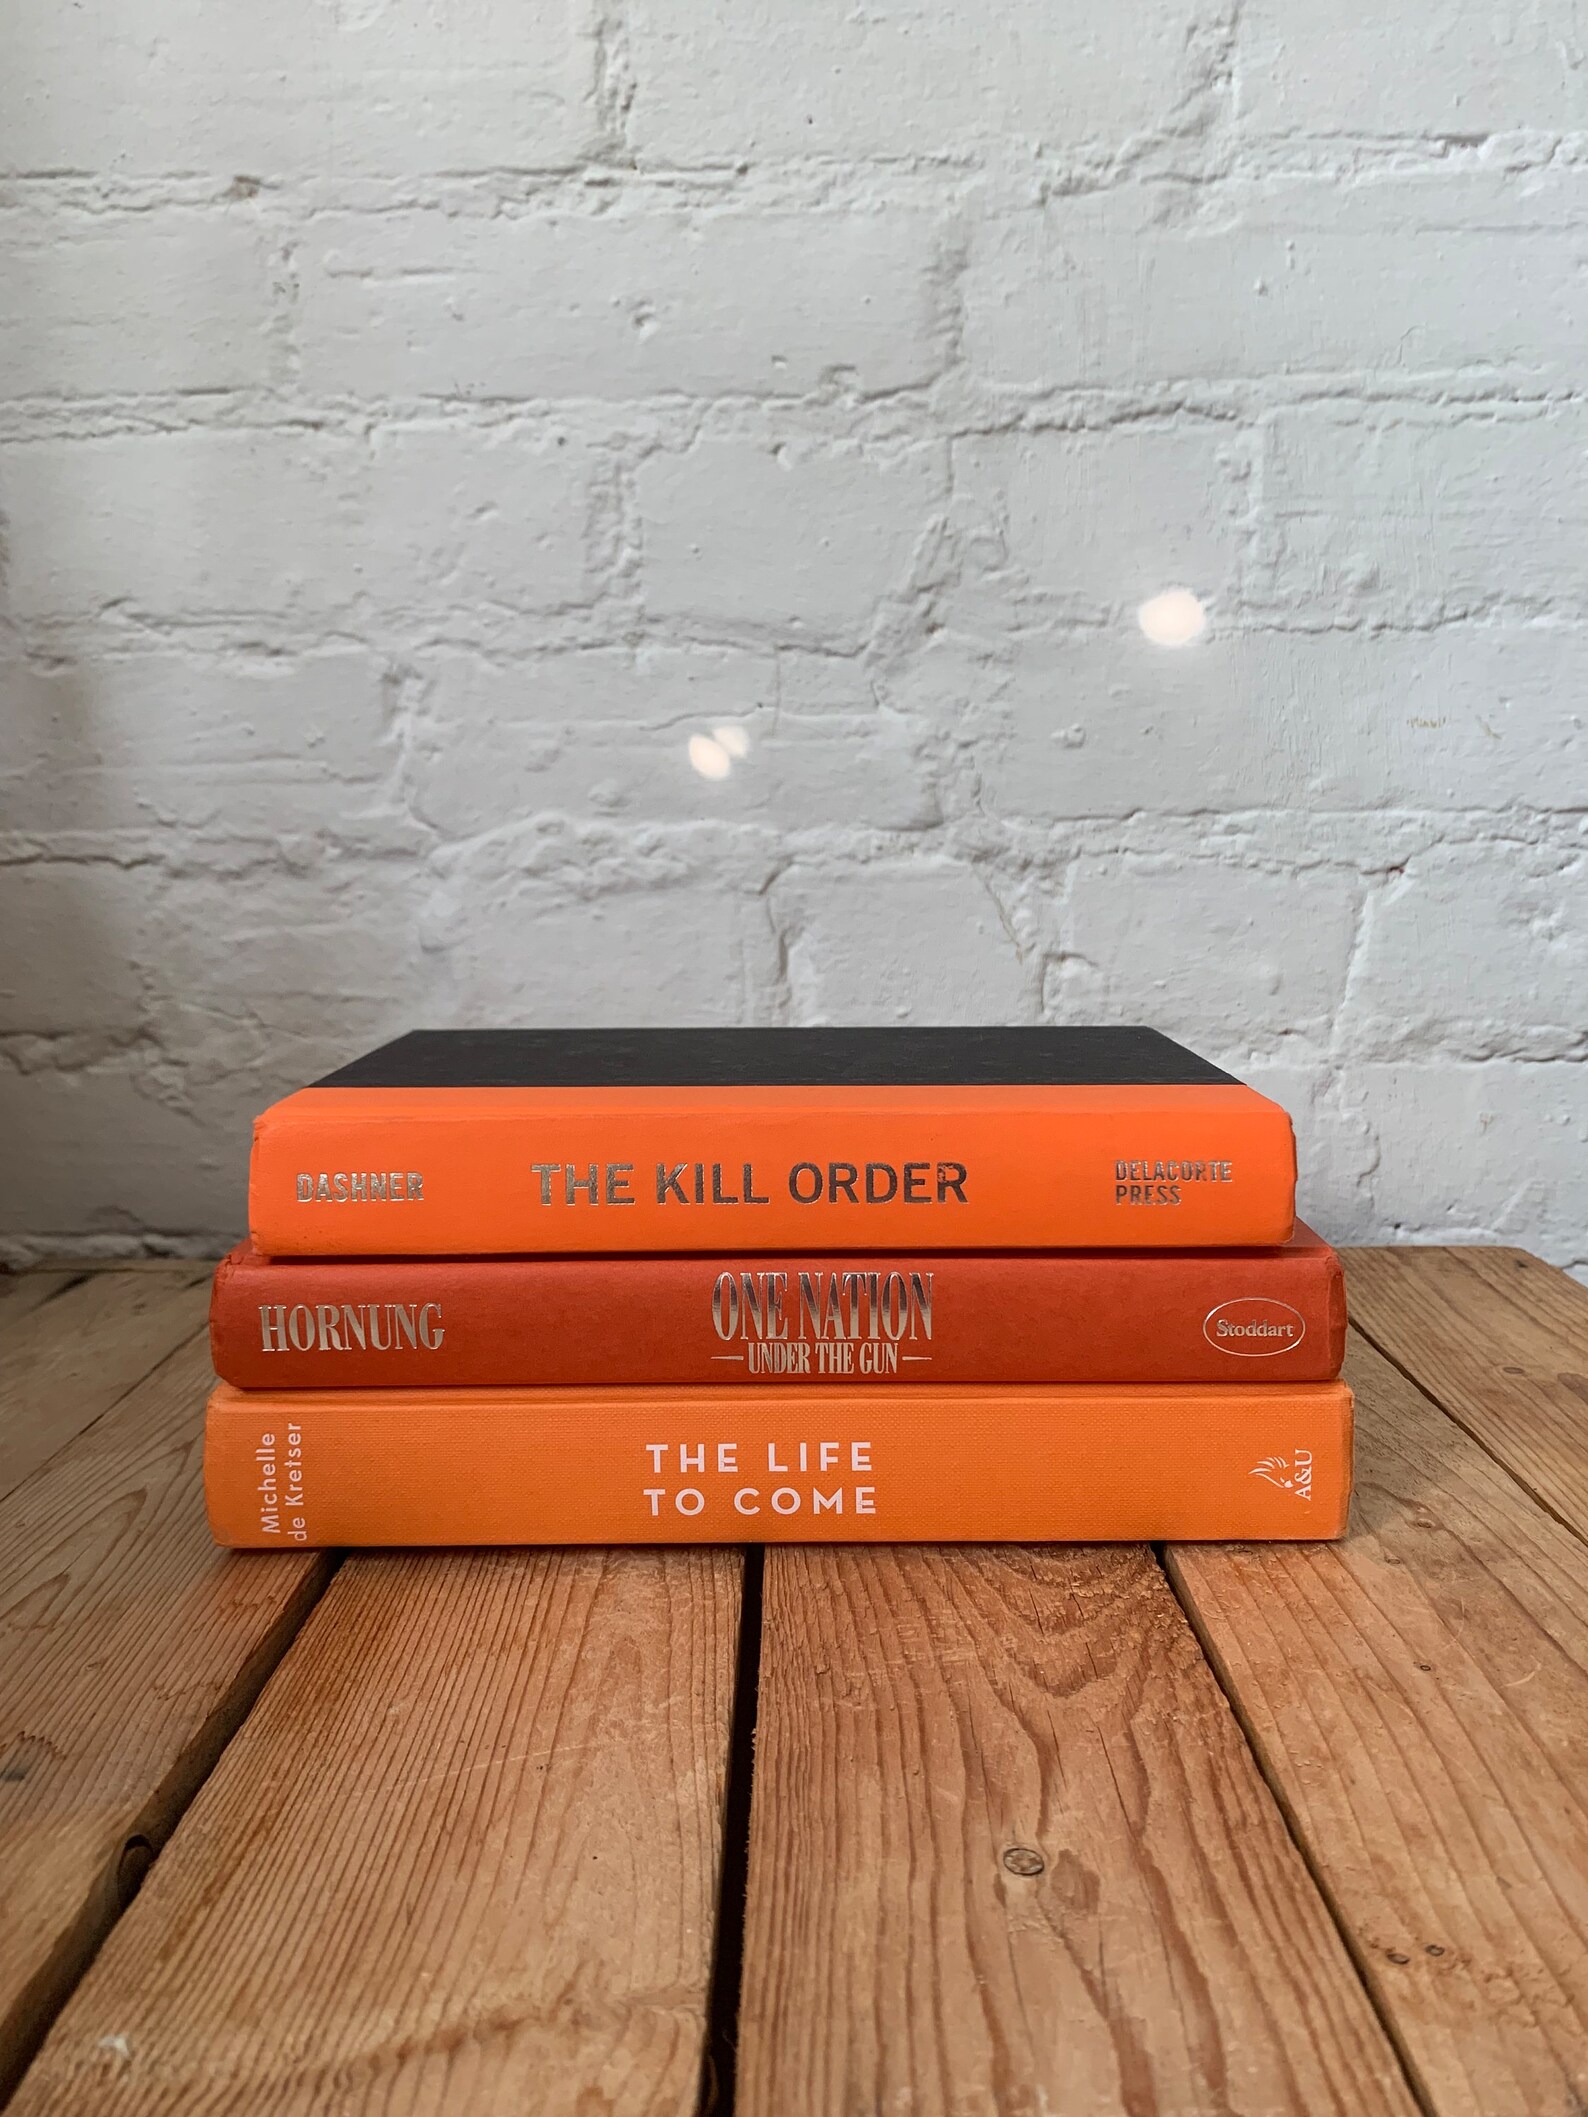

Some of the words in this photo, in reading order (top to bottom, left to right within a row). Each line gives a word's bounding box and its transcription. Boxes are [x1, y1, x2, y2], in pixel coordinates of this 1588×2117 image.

[532, 1163, 636, 1206] THE
[655, 1162, 771, 1205] KILL
[788, 1162, 968, 1204] ORDER
[1115, 1159, 1233, 1182] DELACORTE
[296, 1172, 425, 1203] DASHNER
[1115, 1185, 1183, 1205] PRESS
[711, 1271, 788, 1340] ONE
[799, 1271, 934, 1340] NATION
[259, 1303, 445, 1352] HORNUNG
[1216, 1319, 1293, 1337] Stoddart
[748, 1342, 811, 1375] UNDER
[815, 1342, 854, 1375] THE
[859, 1342, 899, 1375] GUN
[284, 1422, 305, 1506] Kretser
[646, 1443, 739, 1474] THE
[767, 1441, 874, 1473] LIFE
[257, 1432, 281, 1535] Michelle
[1295, 1449, 1313, 1501] A&U
[642, 1487, 706, 1517] TO
[733, 1486, 878, 1517] COME
[288, 1515, 307, 1543] de
